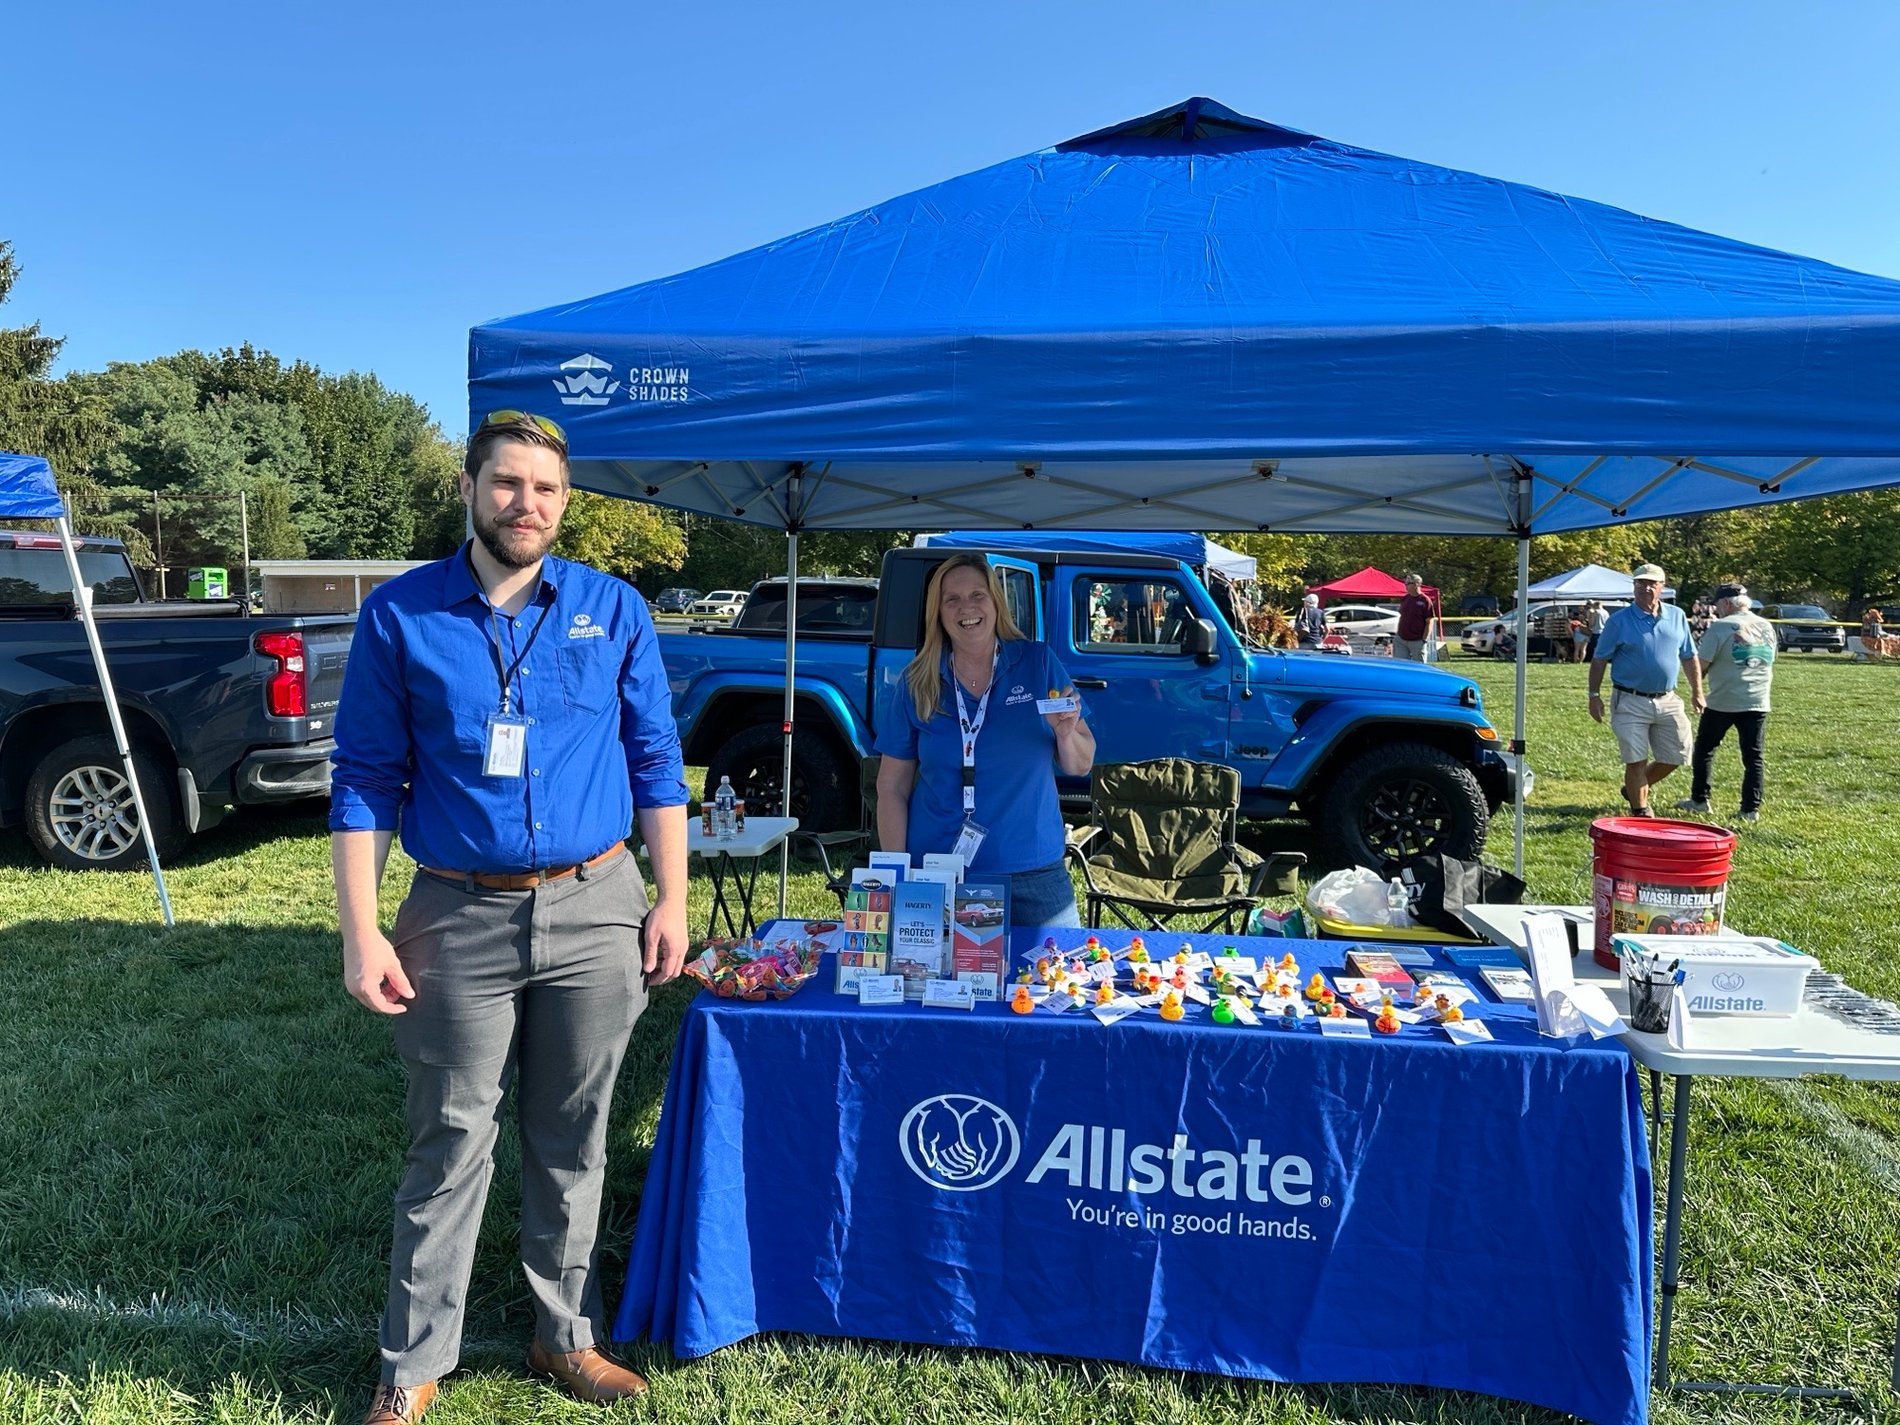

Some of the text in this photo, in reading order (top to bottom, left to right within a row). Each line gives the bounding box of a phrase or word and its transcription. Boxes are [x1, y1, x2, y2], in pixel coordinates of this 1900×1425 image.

[629, 367, 689, 384] CROWN
[629, 386, 688, 401] SHADES
[569, 624, 602, 635] Allstate
[1233, 744, 1269, 757] Jeep
[1638, 890, 1672, 905] WASH
[1680, 893, 1711, 906] DETAIL
[899, 927, 935, 938] PROTECT
[842, 980, 859, 989] Alls
[972, 987, 992, 997] state
[1688, 996, 1763, 1011] Allstate
[1025, 1124, 1313, 1206] Allstate
[1066, 1198, 1317, 1241] You're in good hands.
